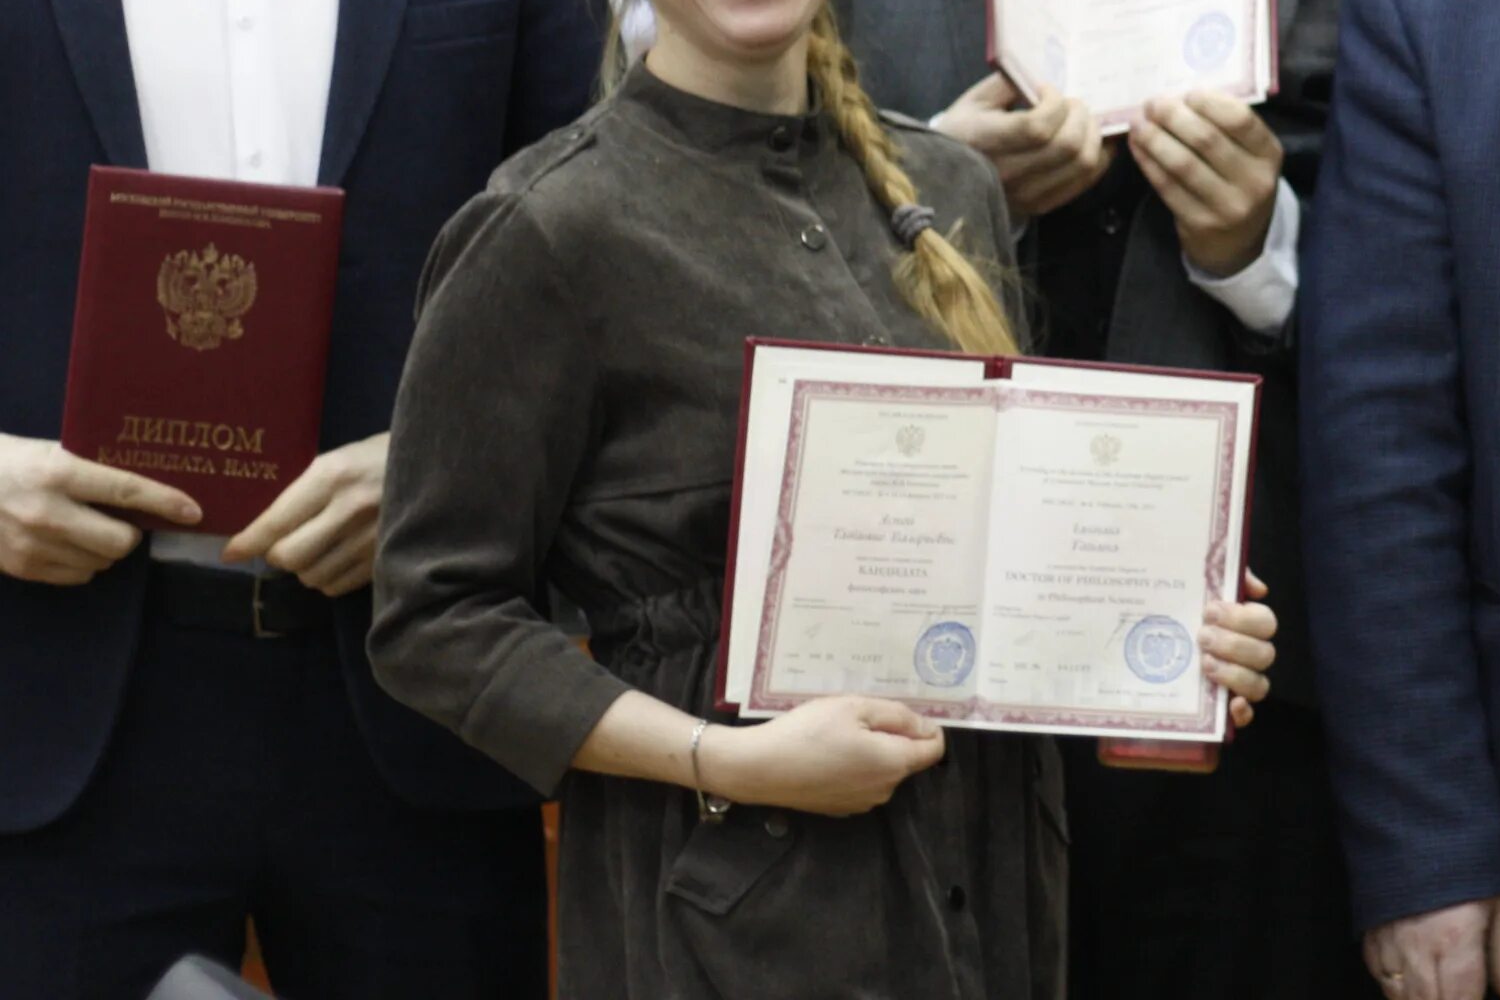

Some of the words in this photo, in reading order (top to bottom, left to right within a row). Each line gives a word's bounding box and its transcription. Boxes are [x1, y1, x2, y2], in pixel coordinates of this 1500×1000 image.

[116, 414, 266, 454] ДИПЛОМ
[97, 447, 217, 475] КАНДИДАТА
[222, 458, 280, 481] НАУК
